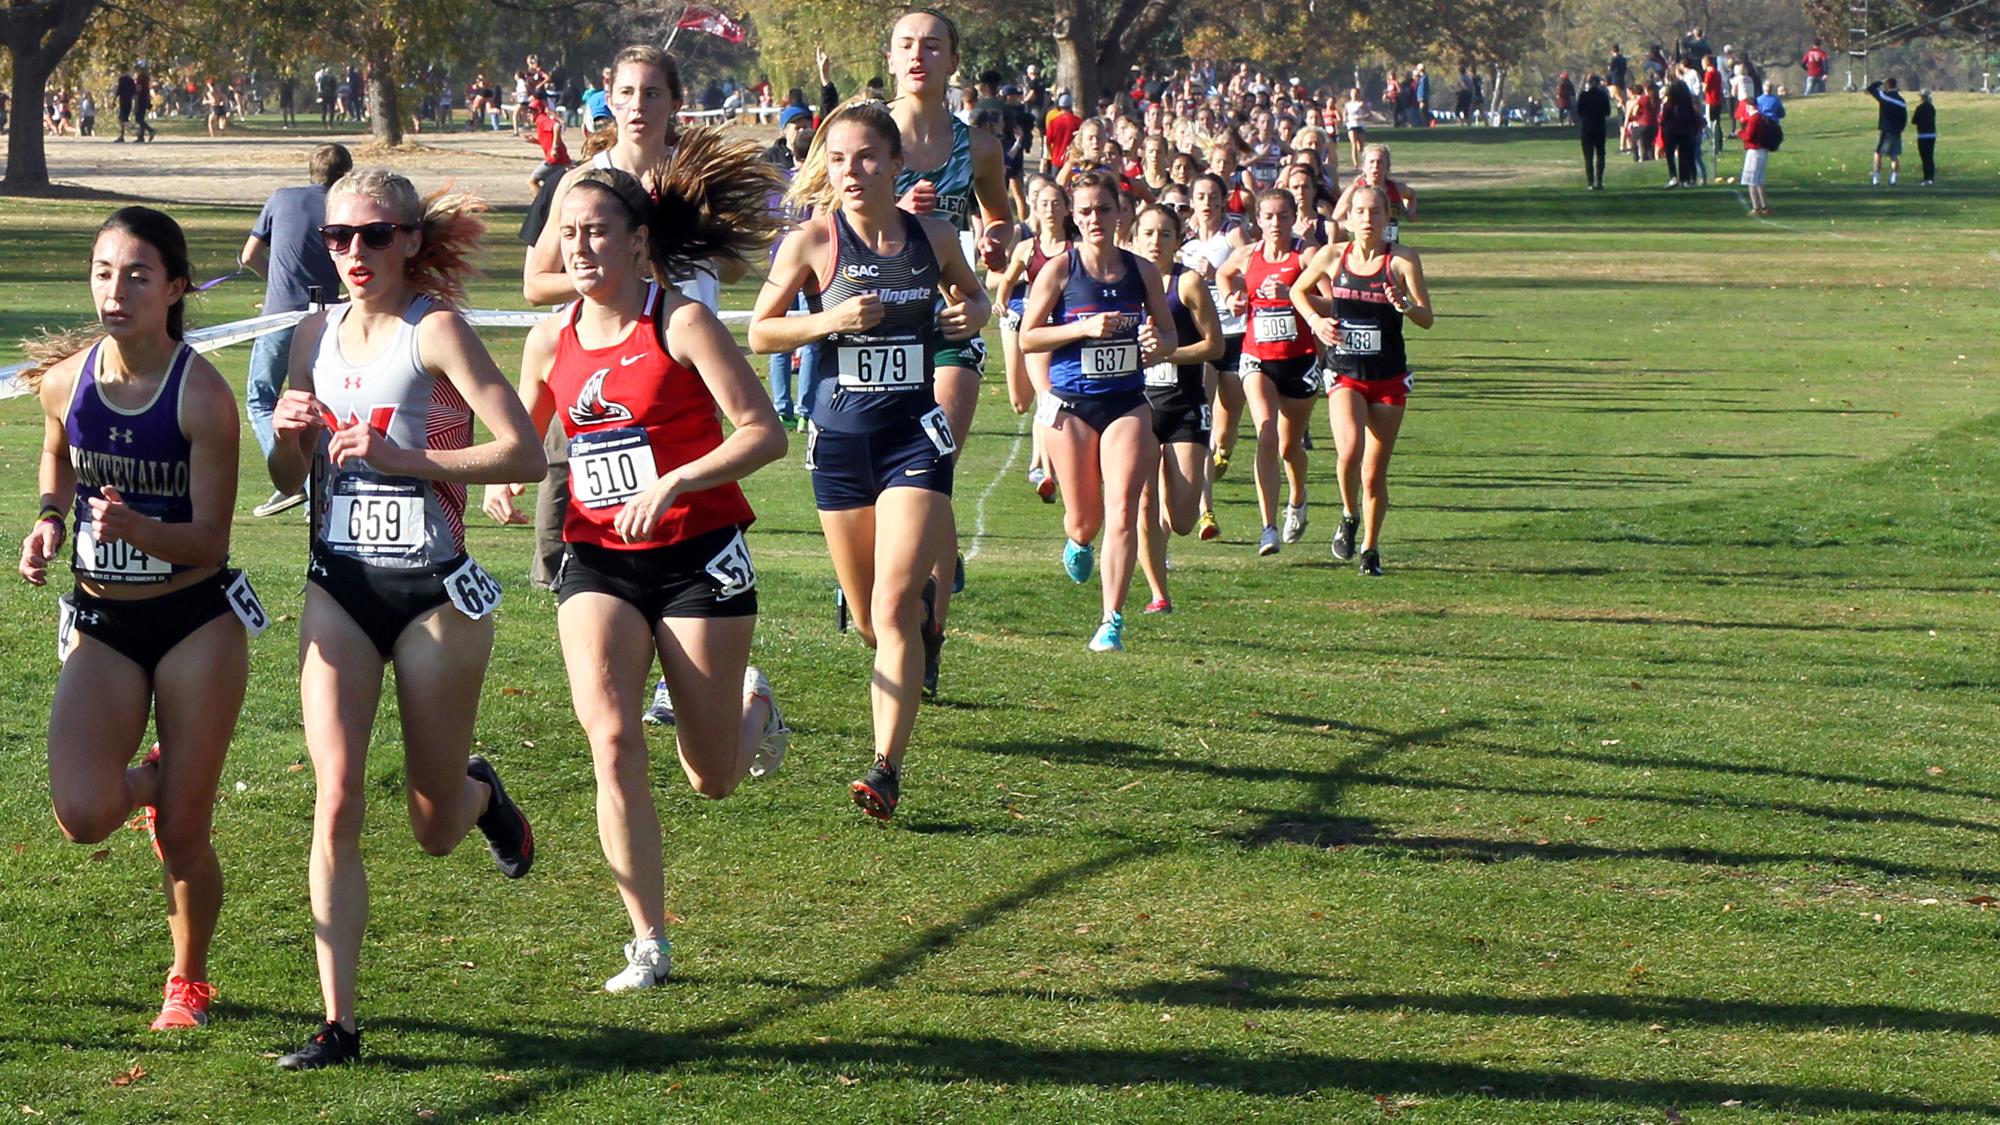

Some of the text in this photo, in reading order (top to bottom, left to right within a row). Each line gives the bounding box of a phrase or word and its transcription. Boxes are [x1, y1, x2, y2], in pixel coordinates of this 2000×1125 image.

[847, 264, 880, 278] SAC
[1262, 318, 1287, 337] 509
[1344, 331, 1371, 350] 438
[858, 347, 906, 383] 679
[1095, 347, 1127, 372] 637
[69, 445, 189, 497] MONTEVALLO
[584, 453, 639, 497] 510
[348, 498, 400, 542] 659
[95, 538, 149, 571] 504
[232, 584, 265, 629] 5
